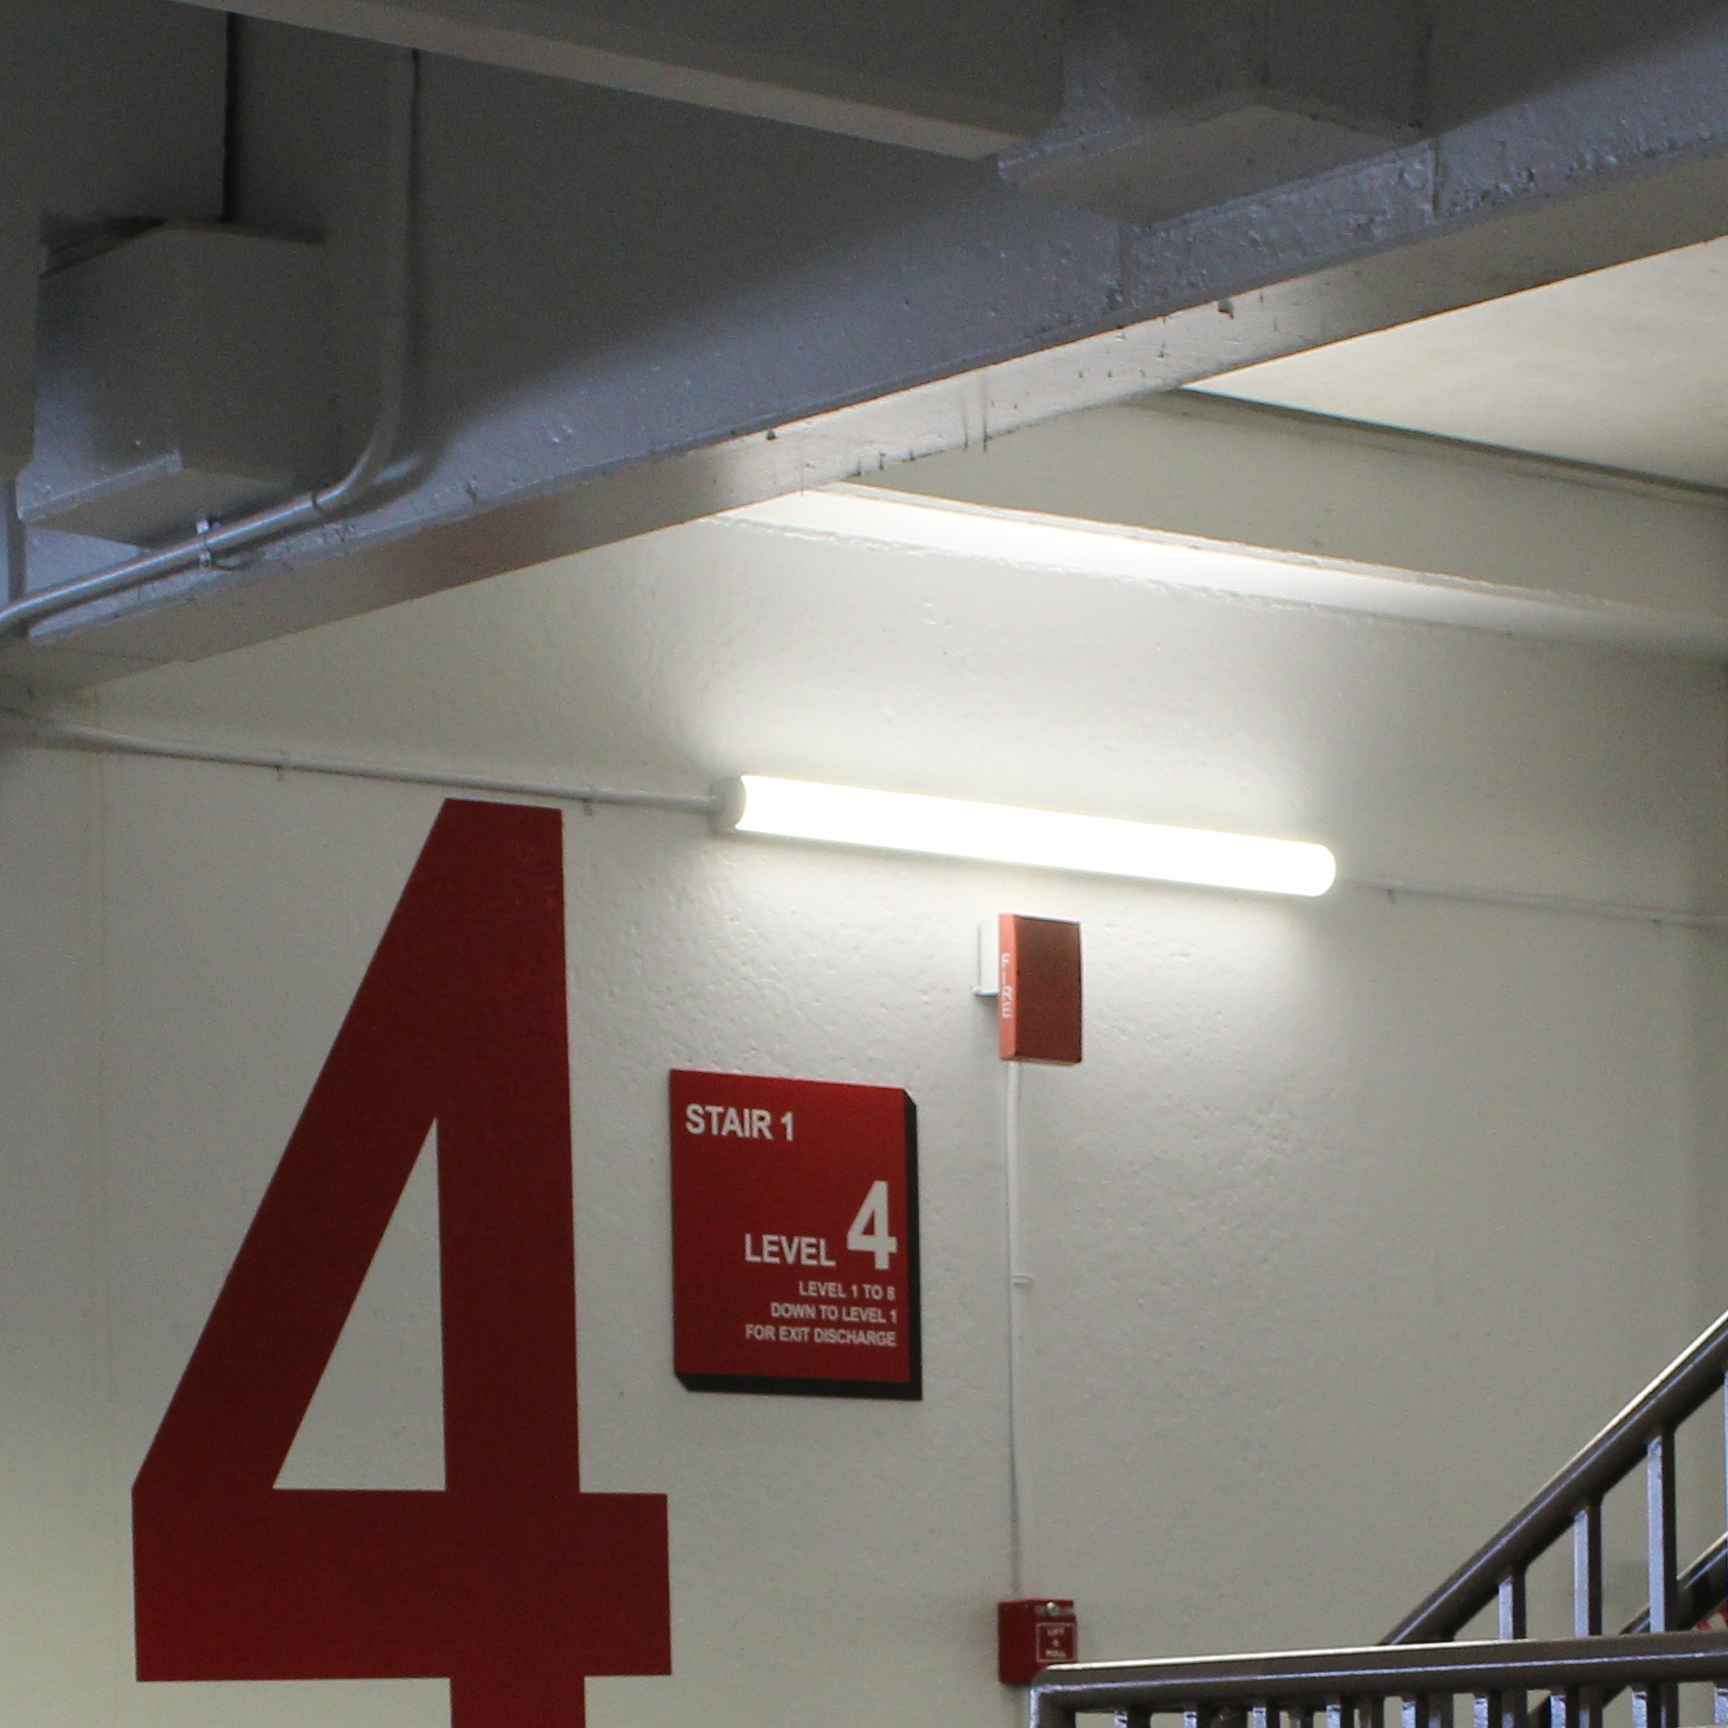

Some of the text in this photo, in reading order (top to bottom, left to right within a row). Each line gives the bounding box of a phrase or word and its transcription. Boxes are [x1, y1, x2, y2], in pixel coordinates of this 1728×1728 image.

[685, 1104, 795, 1142] STAIR 1
[744, 1180, 898, 1271] LEVEL 4
[799, 1281, 847, 1298] LEVEL
[851, 1284, 859, 1299] 1
[863, 1284, 883, 1301] TO
[770, 1302, 897, 1324] DOWN TO LEVEL 1
[745, 1324, 897, 1347] FOR EXIT DISCHARGE
